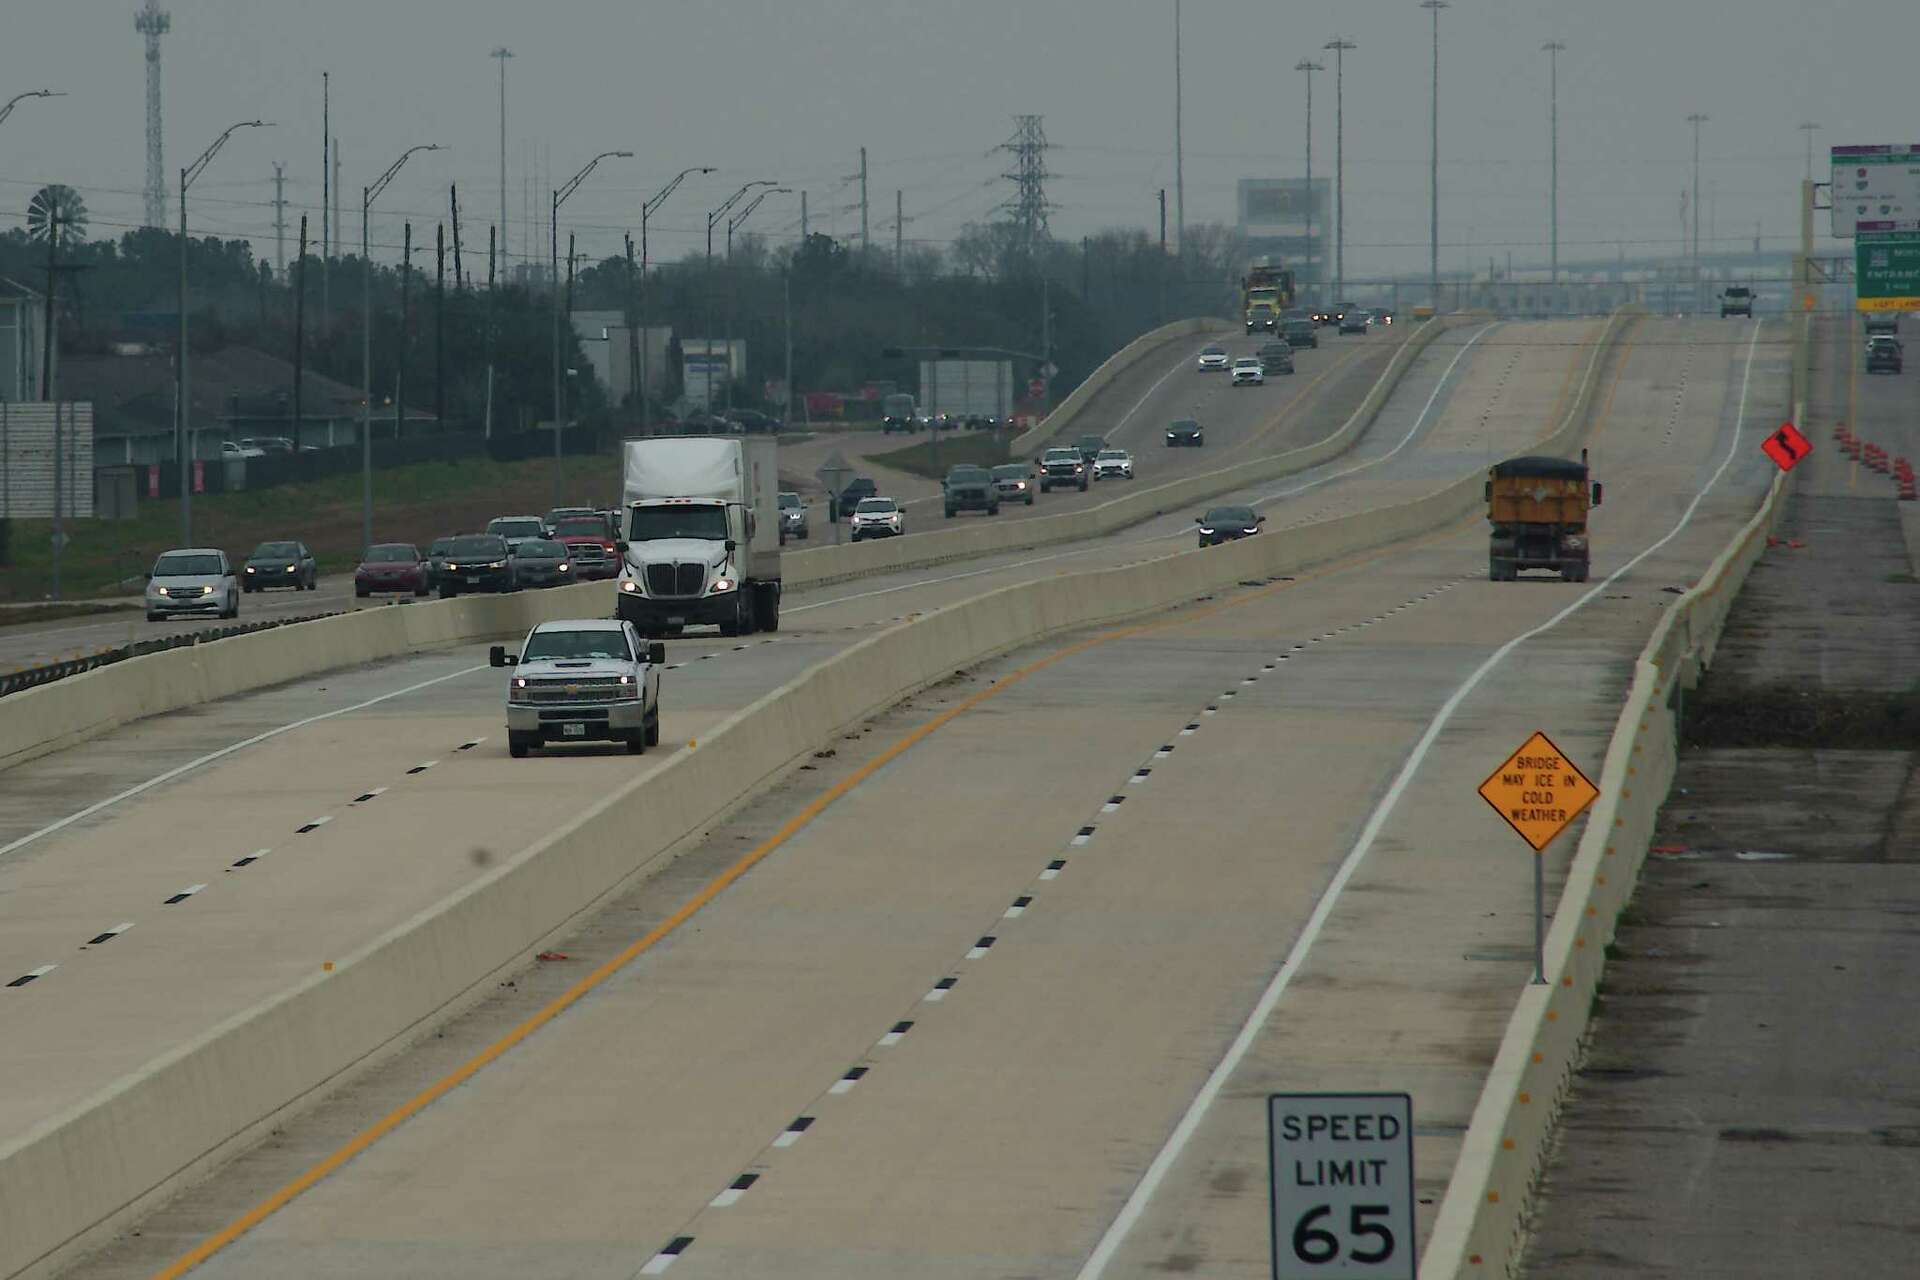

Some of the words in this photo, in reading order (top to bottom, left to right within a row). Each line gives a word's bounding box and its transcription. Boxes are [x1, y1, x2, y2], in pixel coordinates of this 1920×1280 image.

[1516, 756, 1561, 770] BRIDGE
[1502, 774, 1525, 786] MAY
[1535, 774, 1555, 787] ICE
[1563, 775, 1577, 788] IN
[1522, 791, 1554, 804] COLD
[1511, 808, 1567, 822] WEATHER
[1282, 1114, 1400, 1141] SPEED
[1295, 1159, 1388, 1187] LIMIT
[1292, 1204, 1396, 1265] 65
